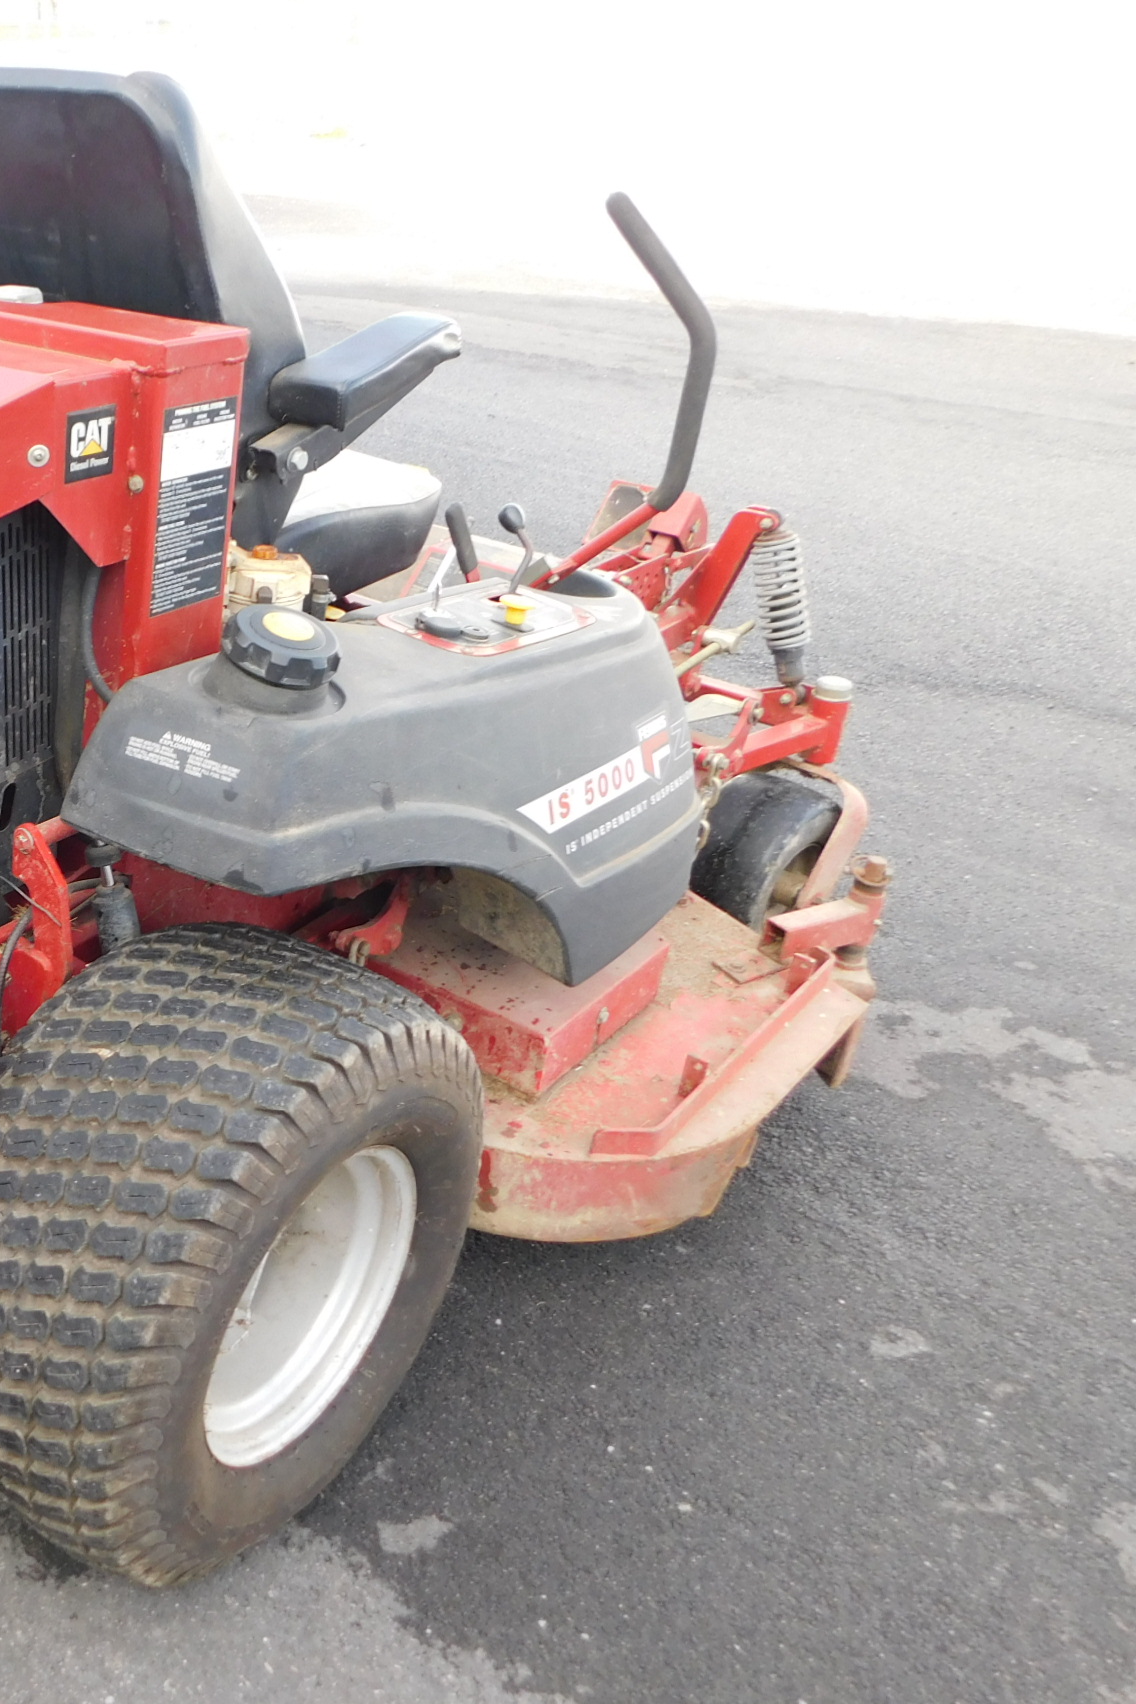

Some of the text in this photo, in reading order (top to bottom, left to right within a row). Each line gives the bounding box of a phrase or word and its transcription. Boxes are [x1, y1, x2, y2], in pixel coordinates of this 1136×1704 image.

[70, 417, 112, 458] CAT
[173, 734, 211, 751] WARNING
[584, 758, 634, 805] 5000
[580, 800, 647, 846] INDEPENDENT
